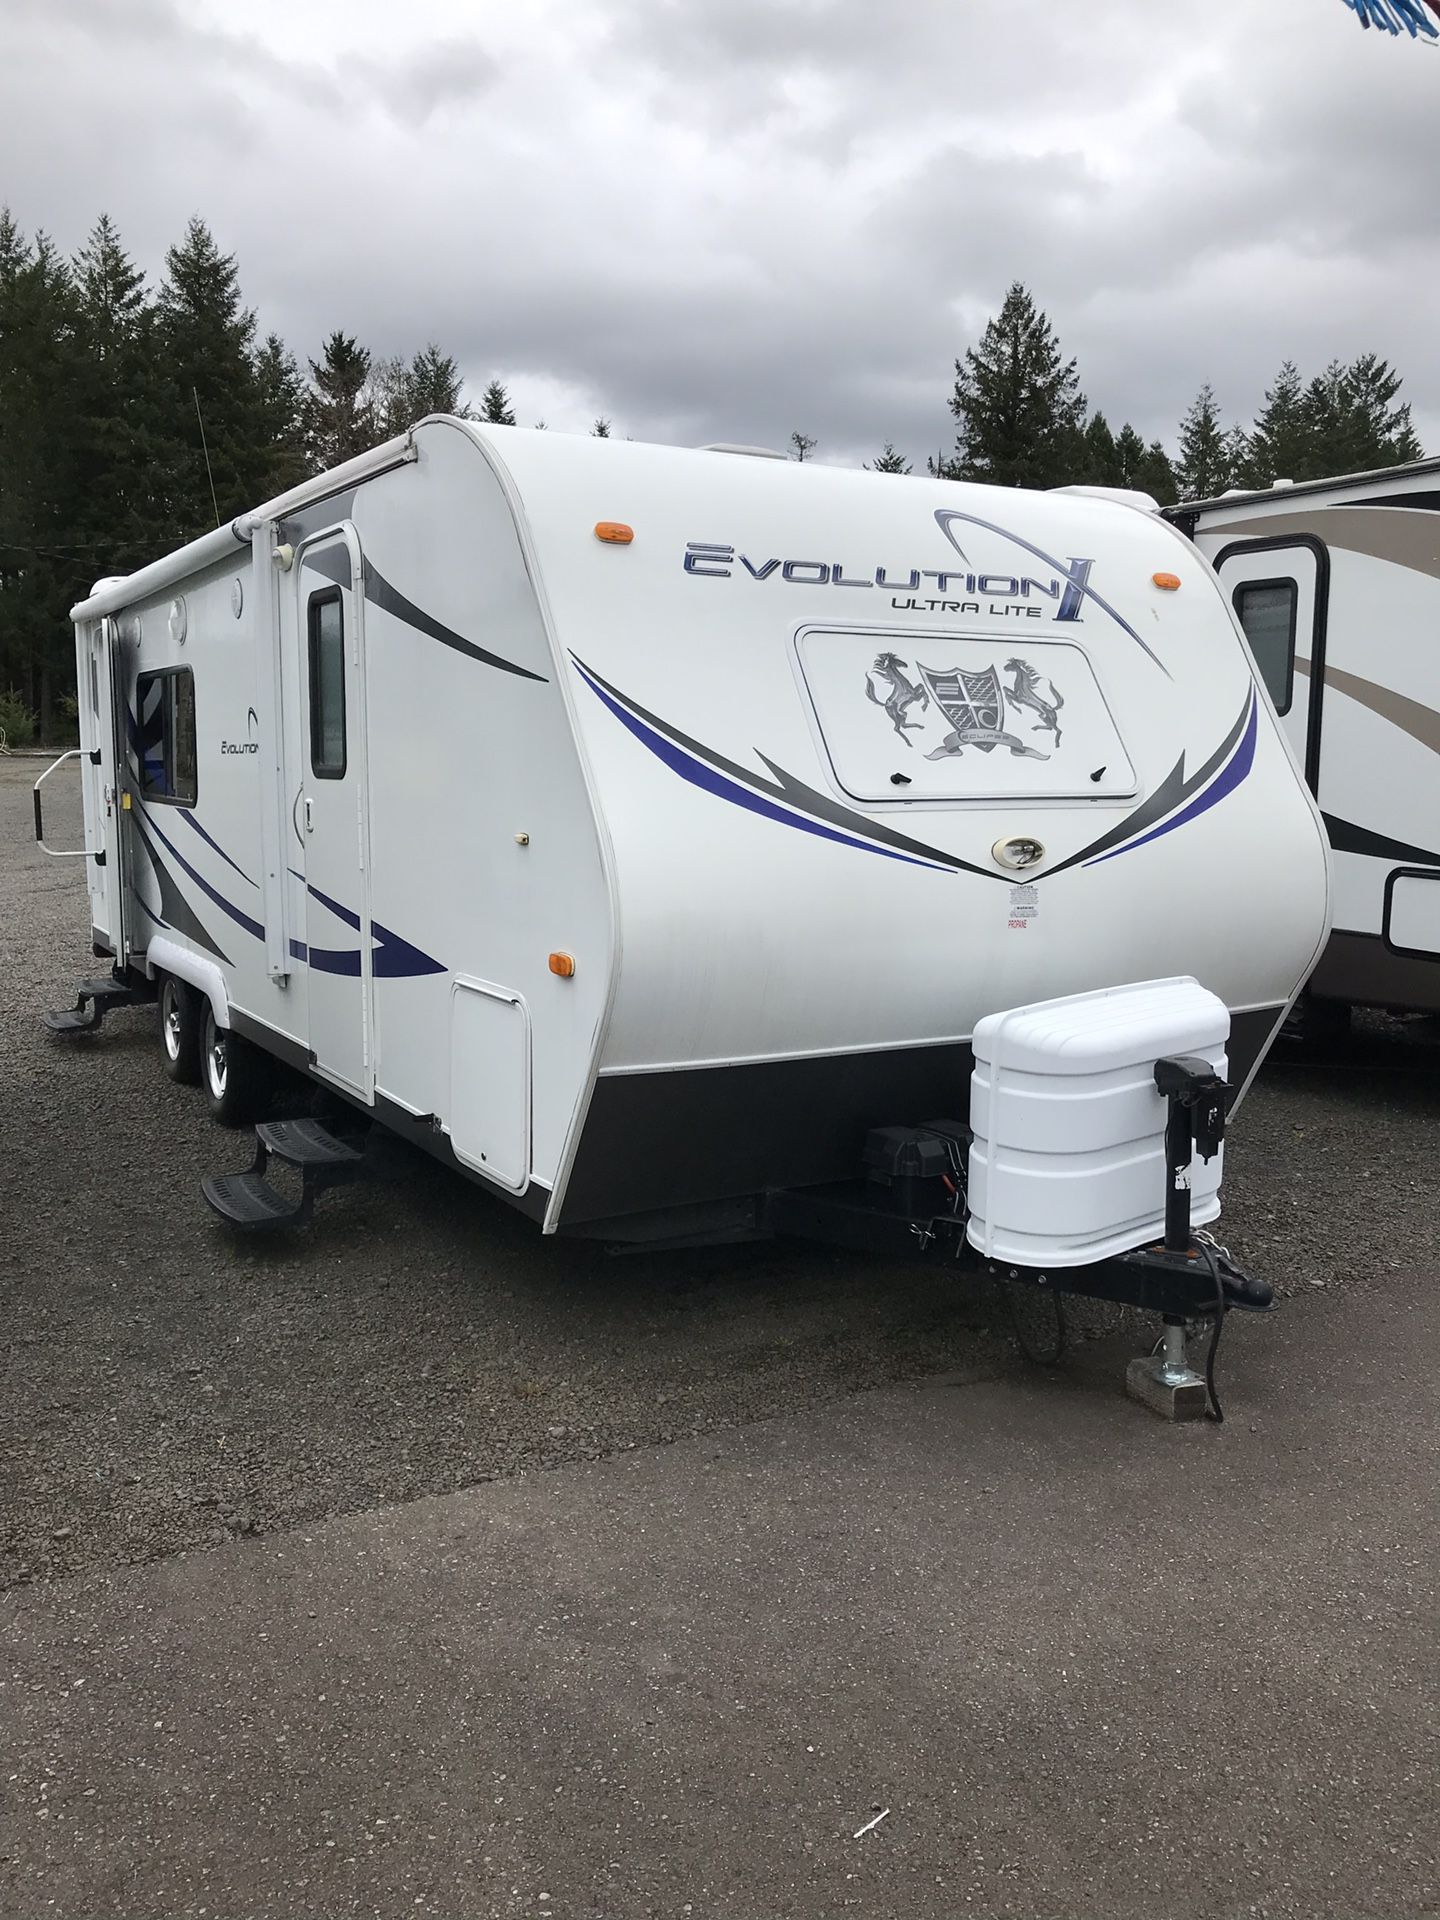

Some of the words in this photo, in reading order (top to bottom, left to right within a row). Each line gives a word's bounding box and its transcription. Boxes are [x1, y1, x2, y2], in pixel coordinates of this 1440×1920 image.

[684, 542, 1059, 599] EVOLUTION
[891, 597, 980, 614] ULTRA
[988, 604, 1043, 618] LITE
